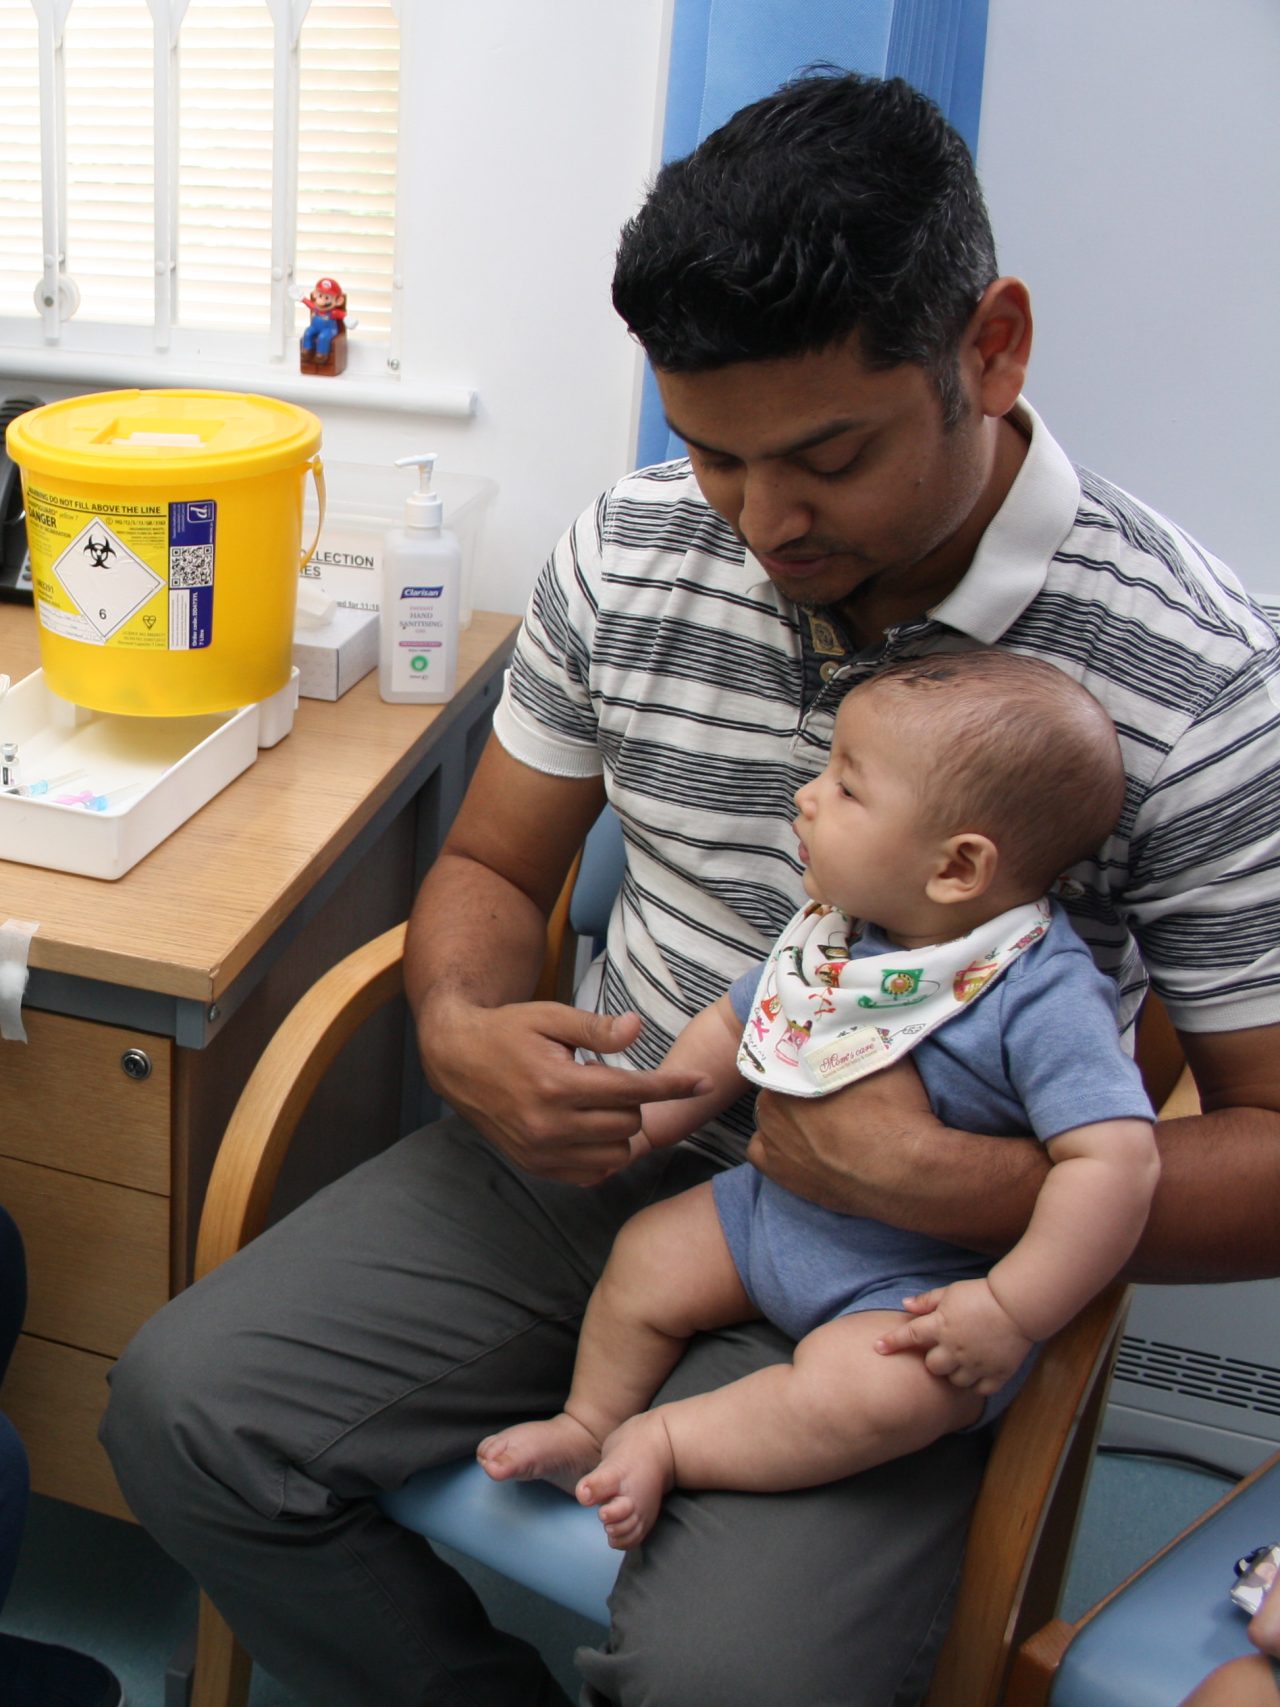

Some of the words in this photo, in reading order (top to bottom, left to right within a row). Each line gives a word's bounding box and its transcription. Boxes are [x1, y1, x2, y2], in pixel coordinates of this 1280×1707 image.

[49, 496, 58, 504] DO
[60, 498, 73, 507] NOT
[74, 501, 89, 510] FILL
[91, 503, 120, 513] ABOVE
[121, 506, 138, 514] THE
[140, 506, 161, 514] LINE
[28, 506, 57, 528] DANGER
[404, 588, 439, 597] Clarisan
[99, 608, 107, 620] 6
[820, 1052, 854, 1073] Mom's
[855, 1043, 874, 1057] care
